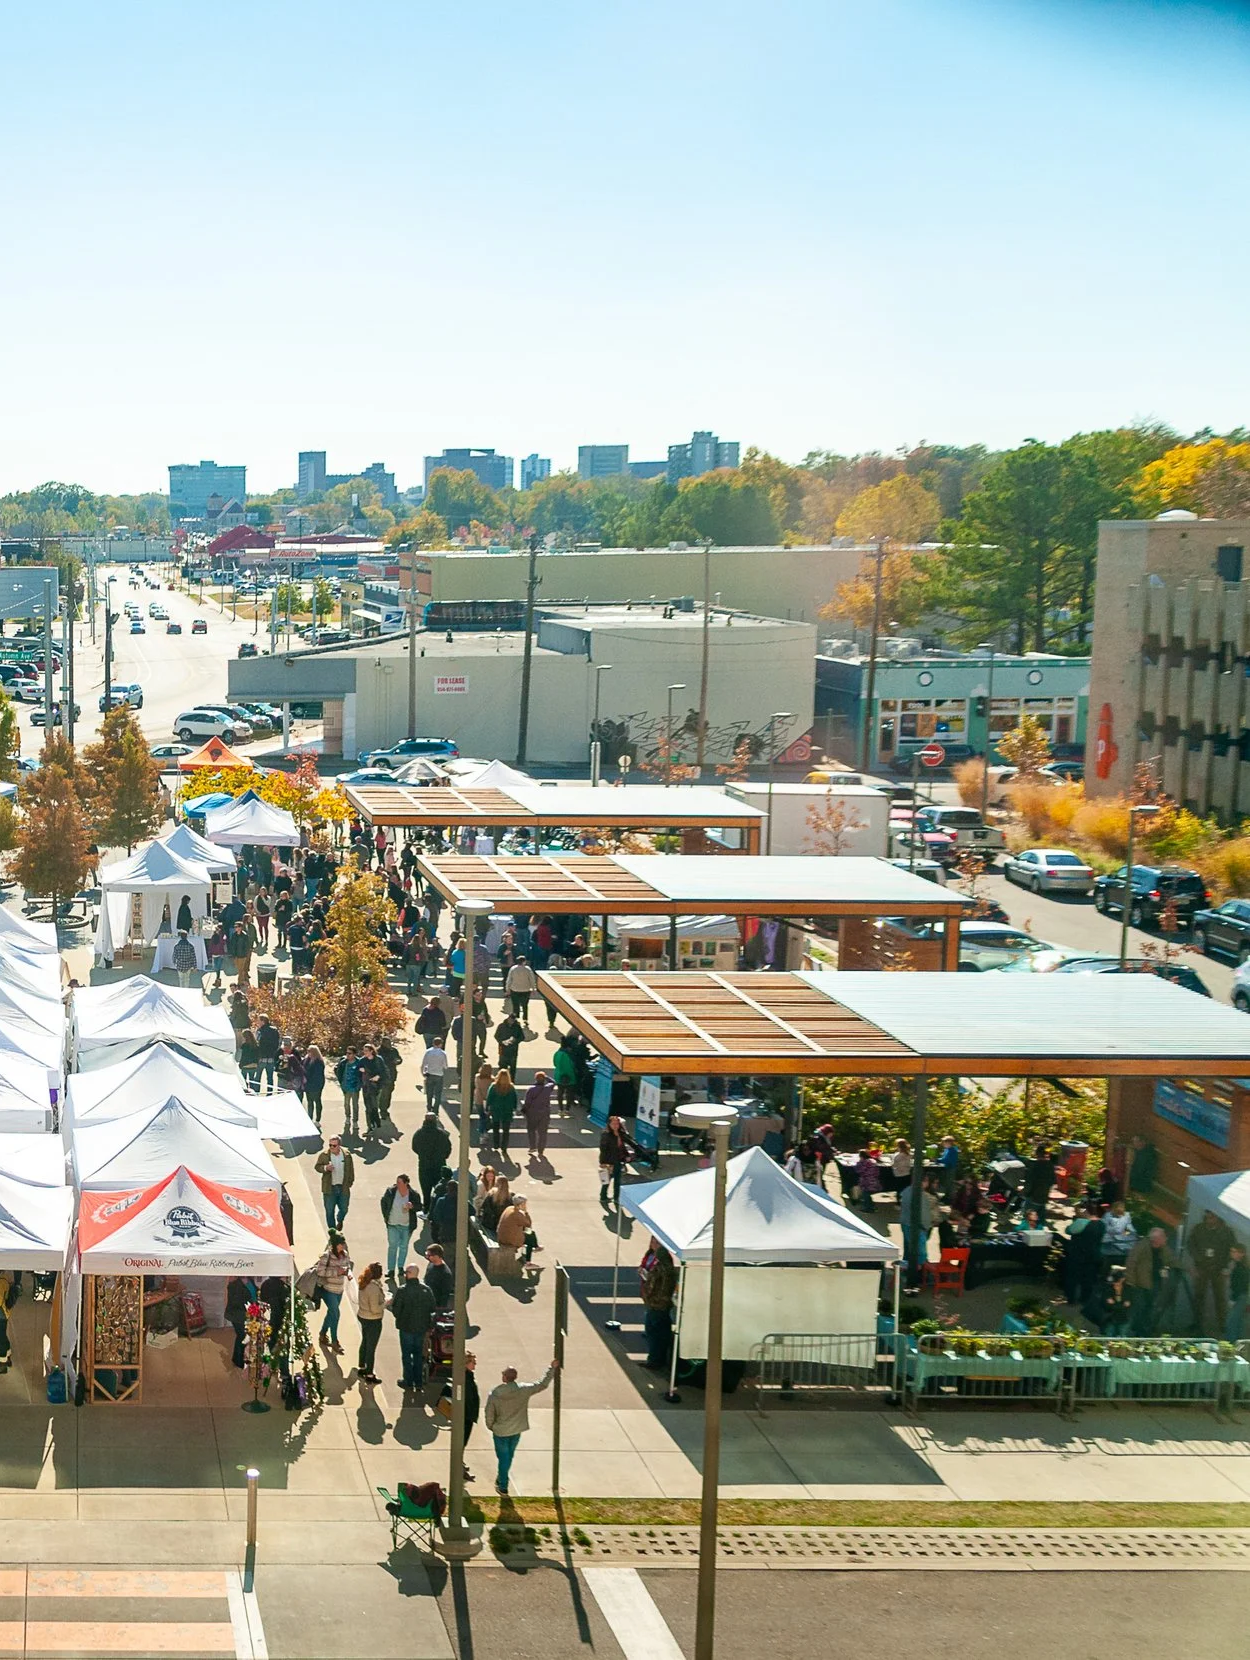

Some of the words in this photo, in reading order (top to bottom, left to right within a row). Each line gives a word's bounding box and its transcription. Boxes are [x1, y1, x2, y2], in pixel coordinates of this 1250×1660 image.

[172, 1209, 194, 1219] Pabst
[165, 1258, 189, 1268] Pabst
[188, 1258, 208, 1268] Blue
[209, 1258, 234, 1268] Ribbon
[235, 1258, 254, 1268] Beer
